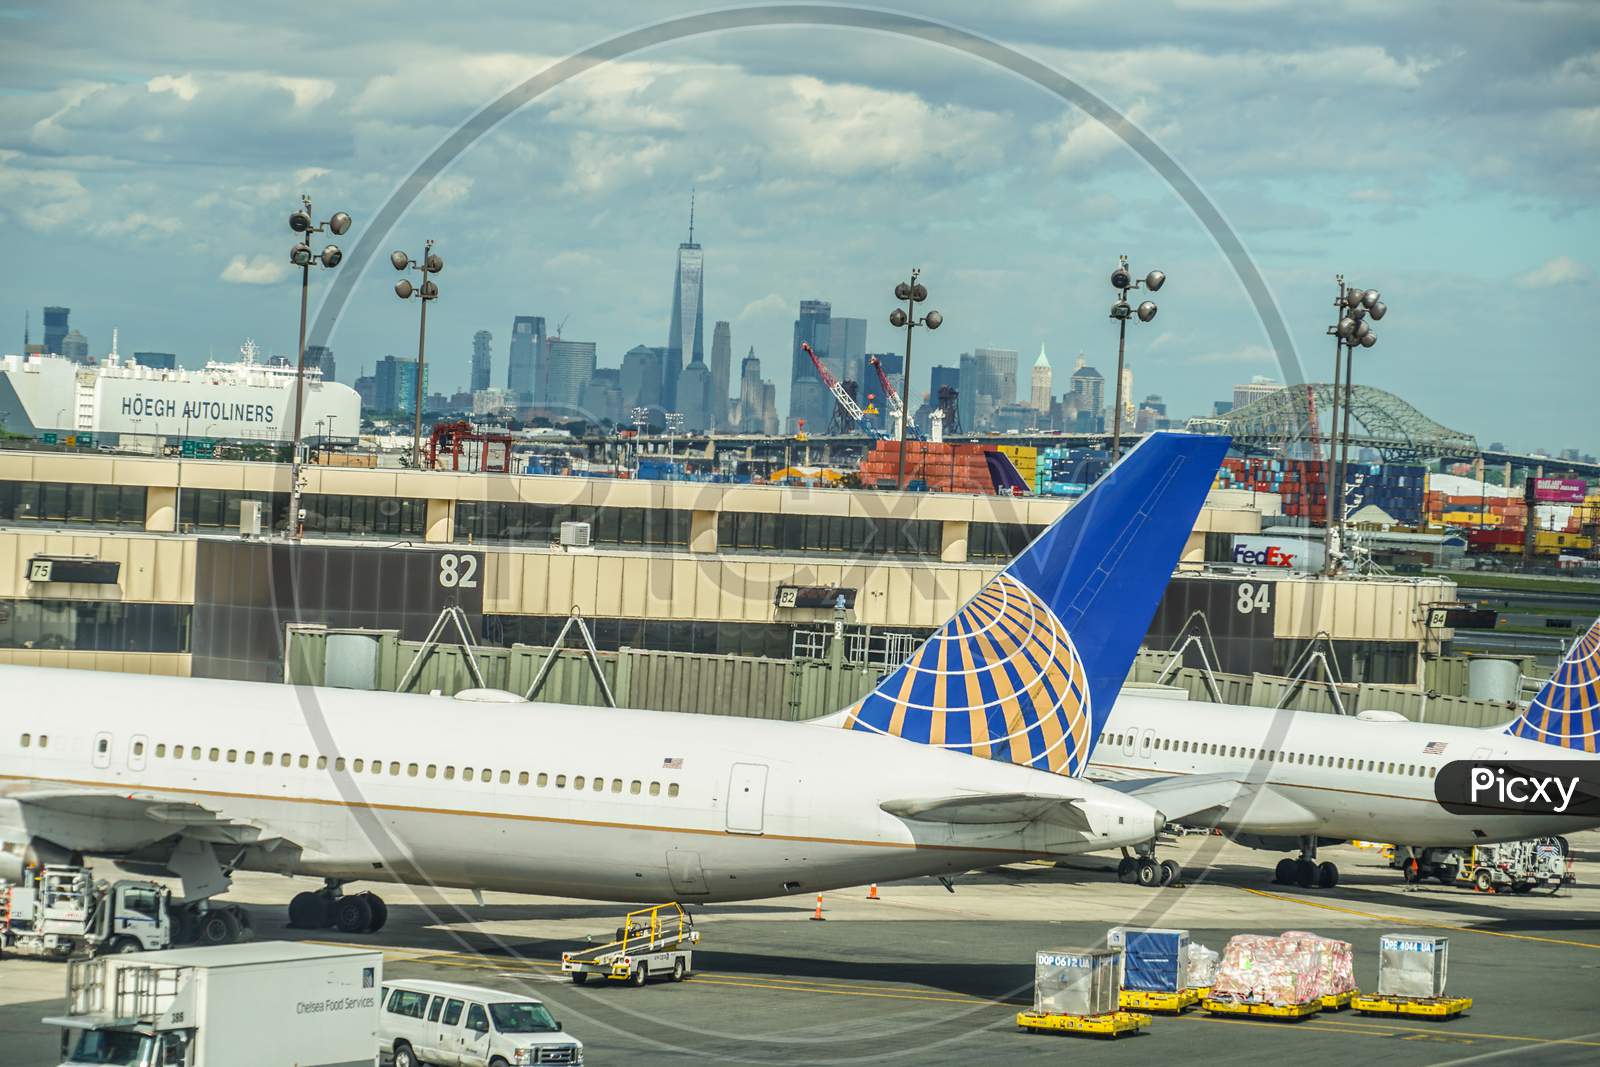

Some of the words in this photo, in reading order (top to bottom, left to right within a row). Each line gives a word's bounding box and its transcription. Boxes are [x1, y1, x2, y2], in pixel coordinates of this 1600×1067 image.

[122, 393, 176, 418] HÖEGH
[182, 401, 274, 423] AUTOLINERS
[1231, 544, 1295, 568] FedEx
[34, 565, 49, 577] 75
[440, 554, 477, 588] 82
[781, 592, 795, 603] 82
[1237, 583, 1271, 614] 84
[1433, 613, 1444, 624] 84
[1079, 958, 1090, 969] UA
[296, 1001, 325, 1014] Chelsea
[325, 998, 344, 1011] Food
[344, 996, 374, 1010] Services
